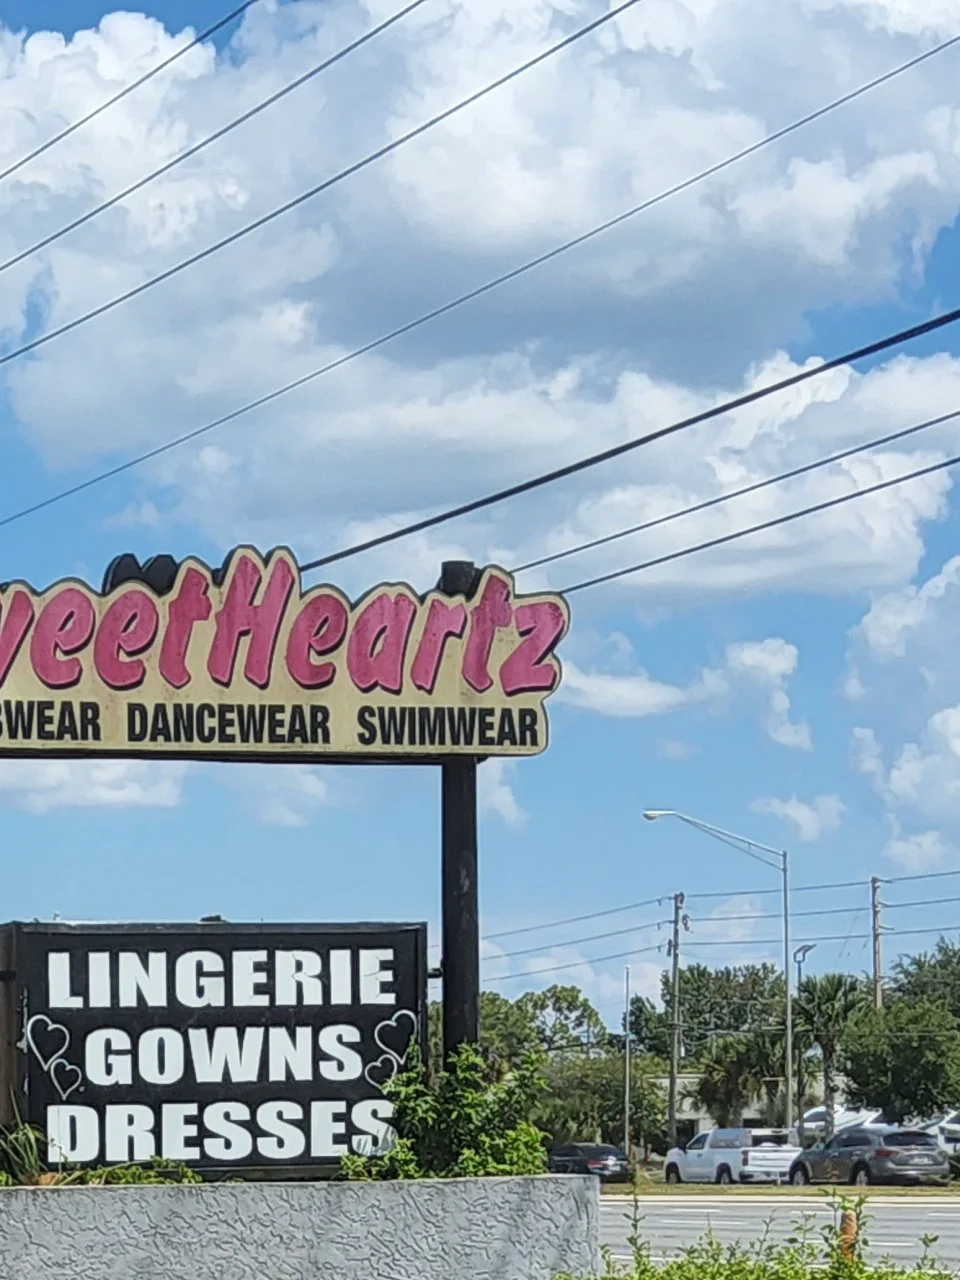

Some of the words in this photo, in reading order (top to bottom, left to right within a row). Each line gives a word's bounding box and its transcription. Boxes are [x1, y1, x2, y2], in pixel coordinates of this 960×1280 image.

[127, 702, 330, 745] DANCEWEAR
[357, 704, 539, 747] SWIMWEAR
[48, 948, 397, 1008] LINGERIE
[85, 1024, 363, 1085] GOWNS
[47, 1100, 398, 1163] DRESSES
